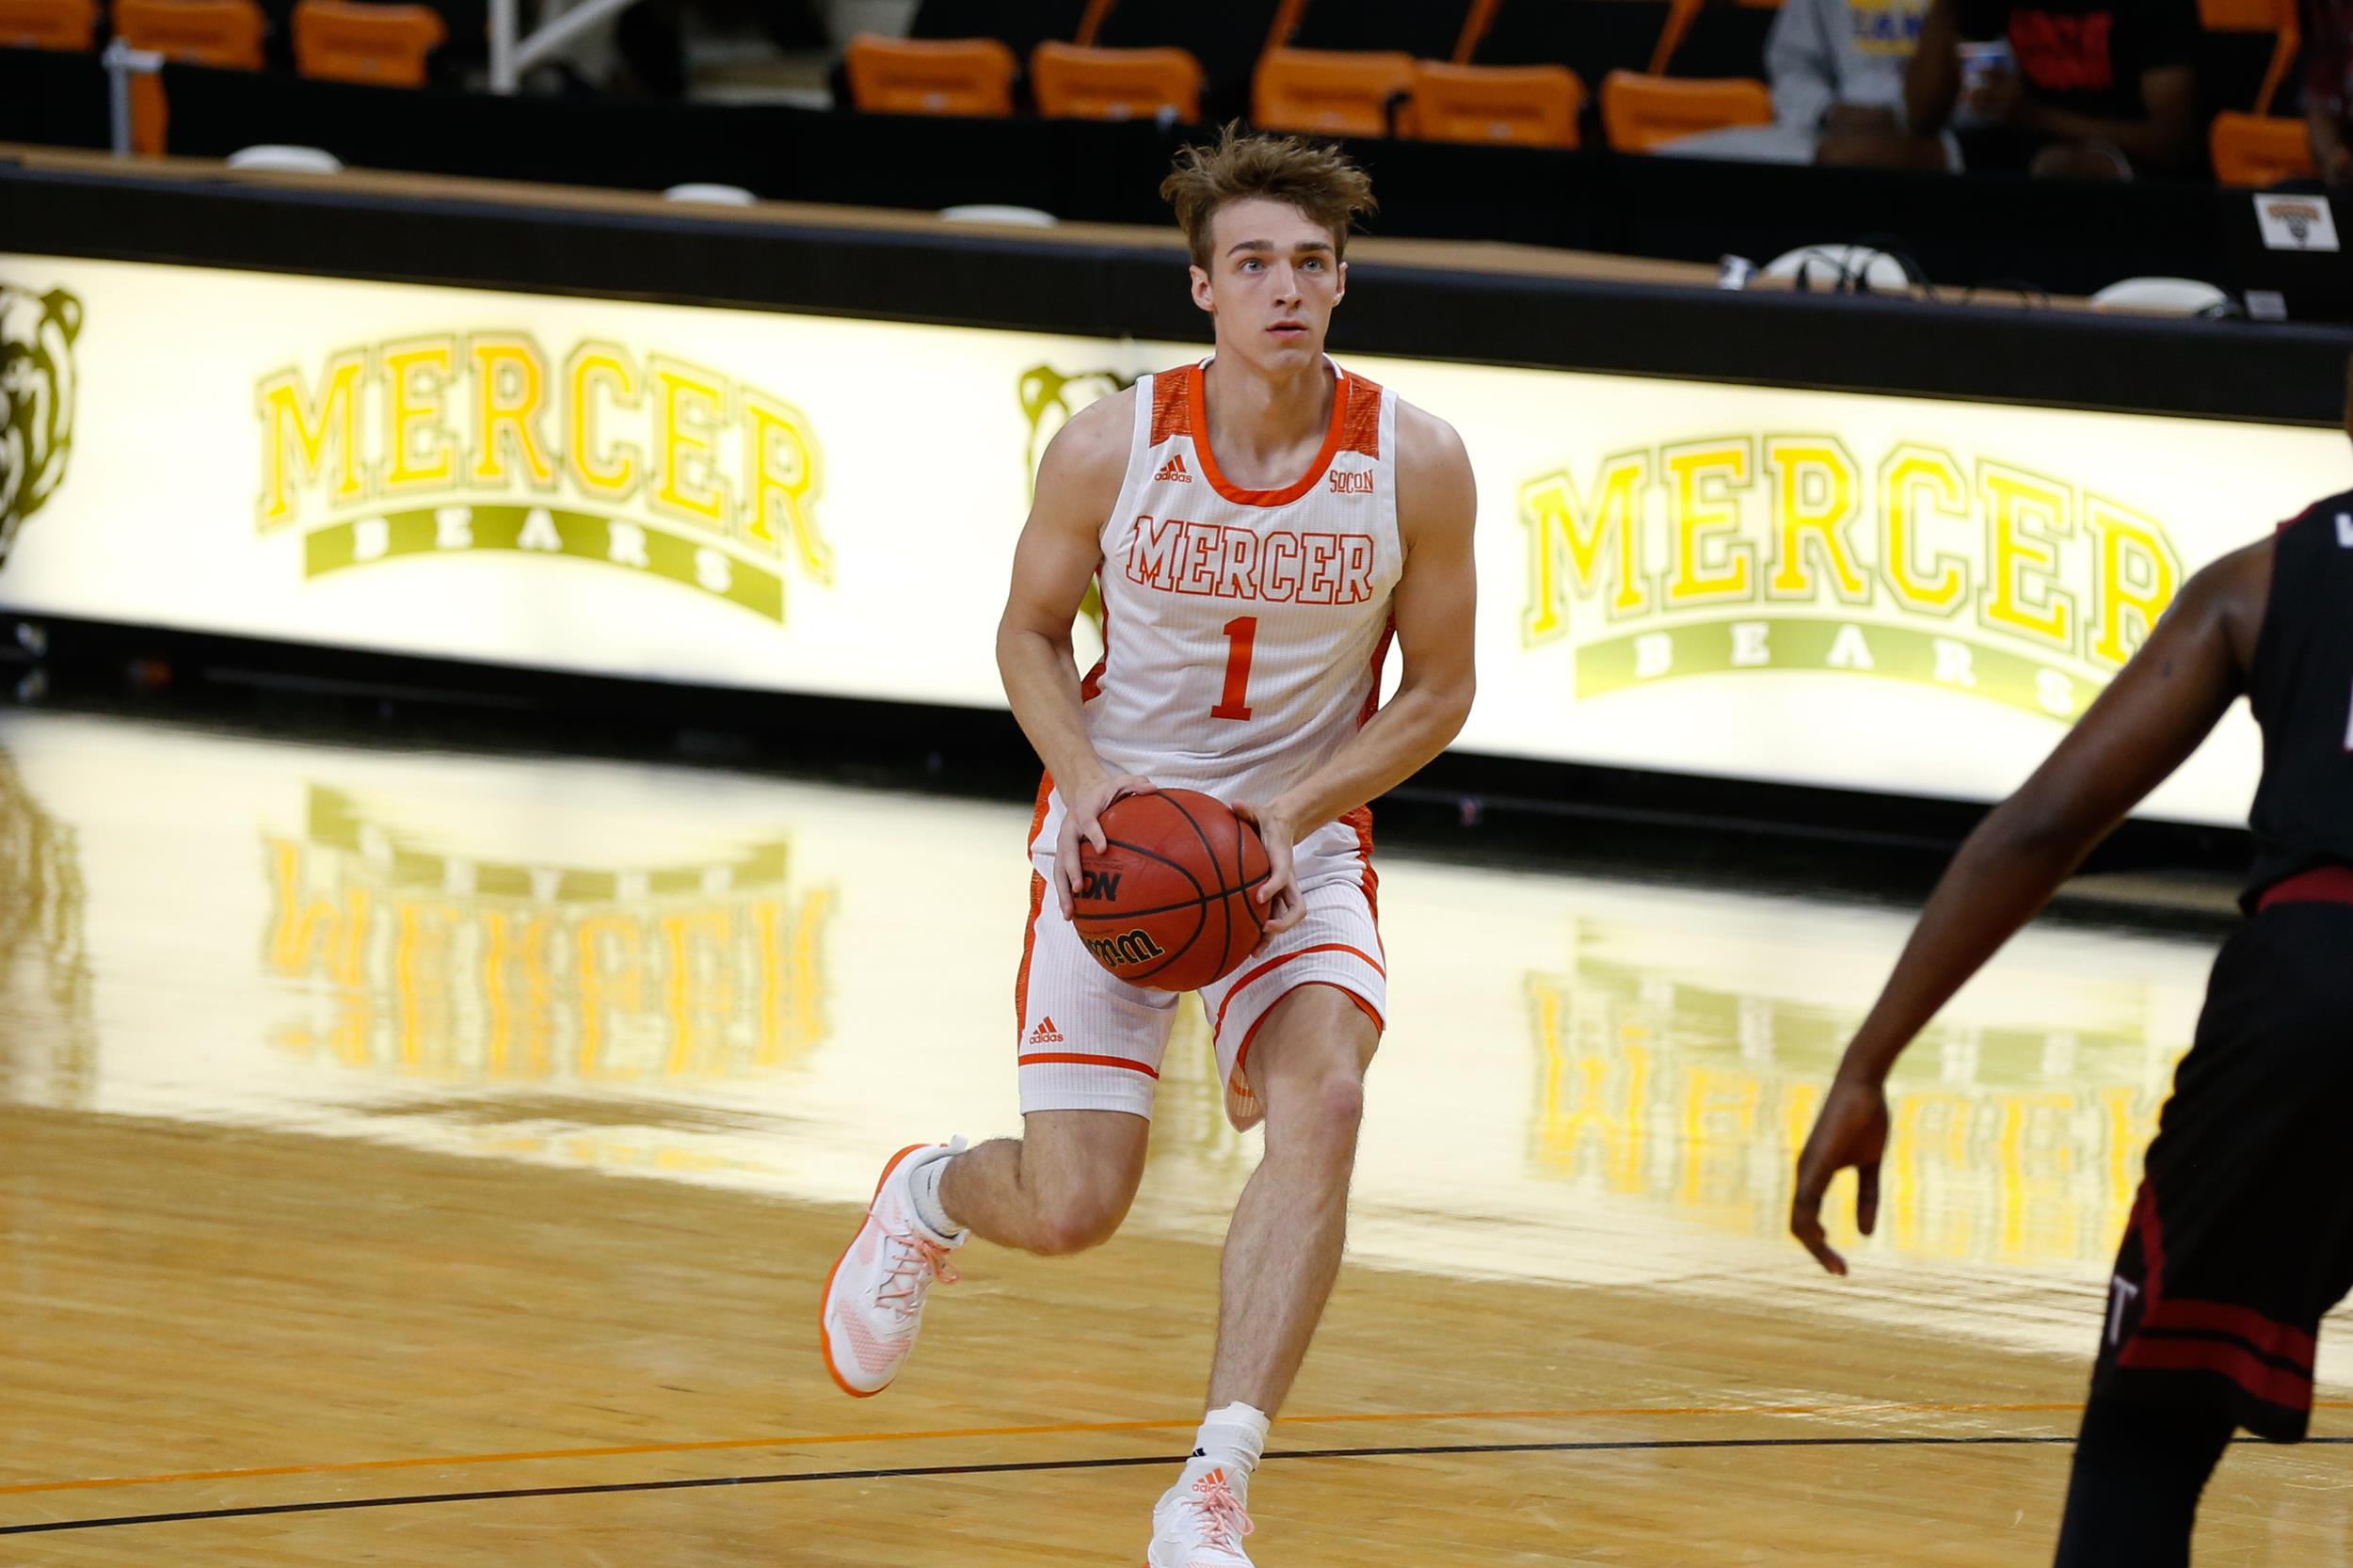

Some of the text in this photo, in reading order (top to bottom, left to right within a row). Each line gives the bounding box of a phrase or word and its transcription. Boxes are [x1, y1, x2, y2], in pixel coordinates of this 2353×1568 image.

[255, 330, 834, 588] MERCER
[1154, 471, 1193, 483] adidas
[351, 505, 734, 594] BEARS
[1126, 515, 1374, 604] MERCER
[1519, 433, 2184, 676] MERCER
[1210, 616, 1257, 722] 1
[1633, 621, 2074, 715] BEARS
[1029, 1032, 1064, 1045] adidas
